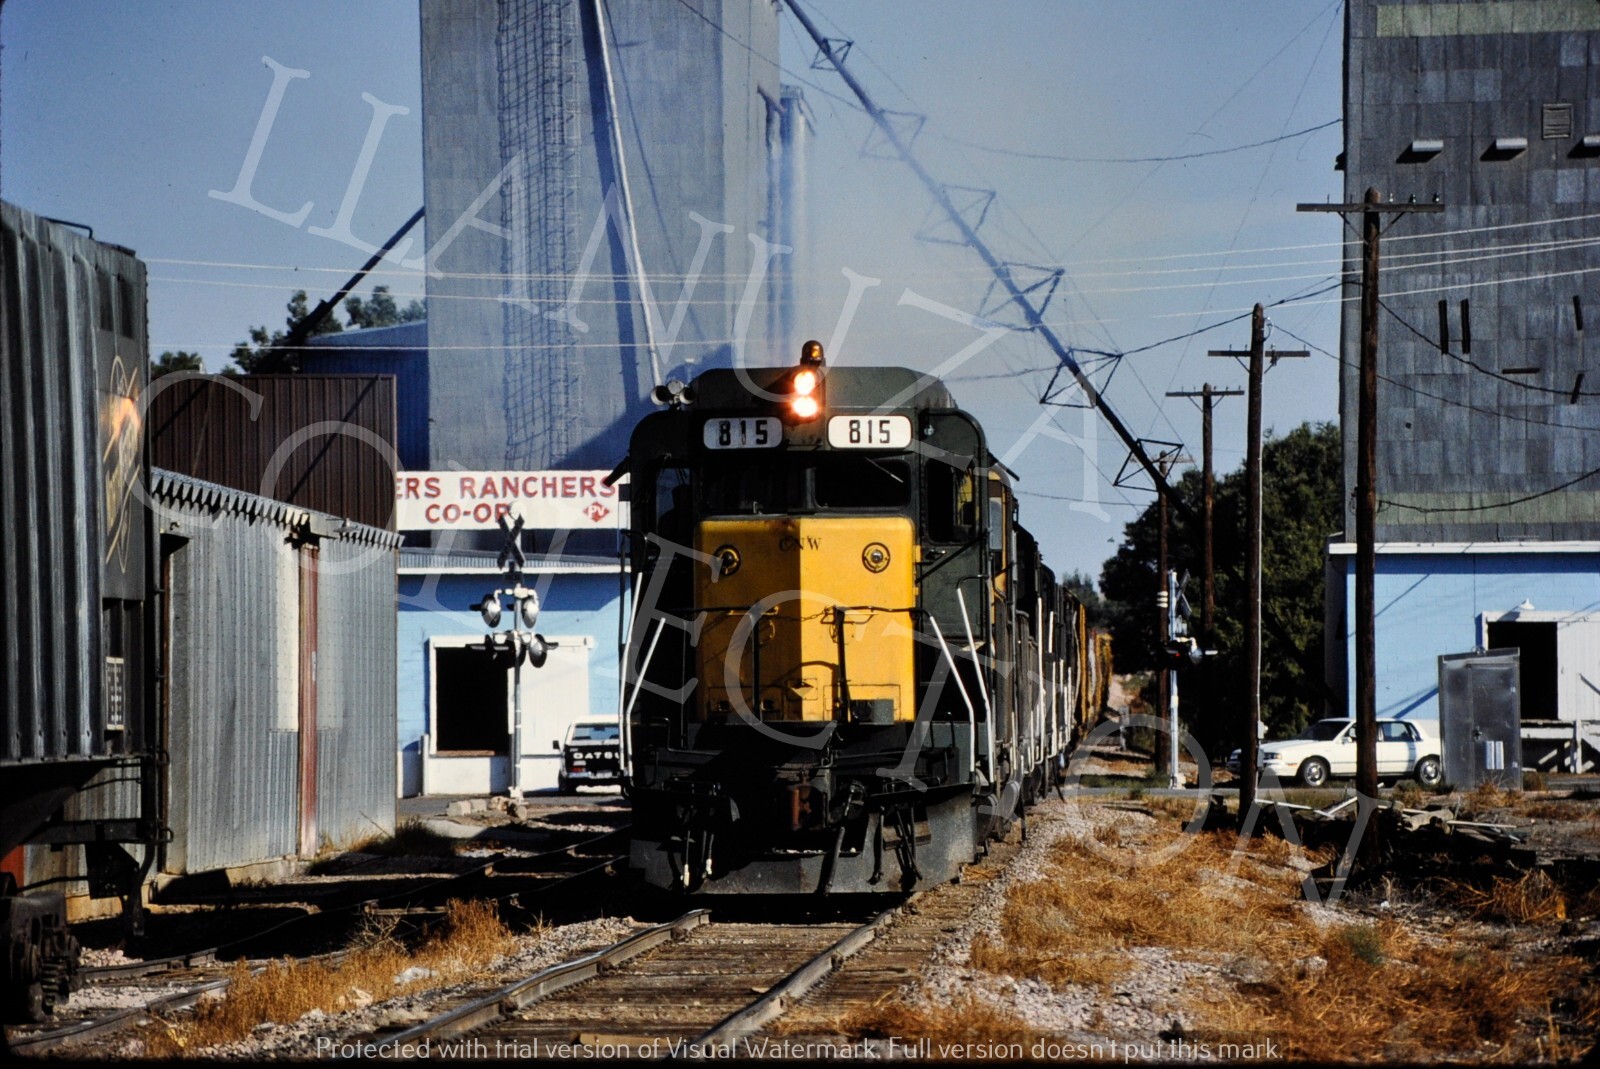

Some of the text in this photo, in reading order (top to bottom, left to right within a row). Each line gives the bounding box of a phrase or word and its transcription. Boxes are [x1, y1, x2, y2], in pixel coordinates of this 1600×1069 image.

[718, 419, 769, 446] 815
[849, 419, 891, 444] 815
[460, 476, 616, 499] RANCHERS
[425, 503, 510, 524] CO-OP
